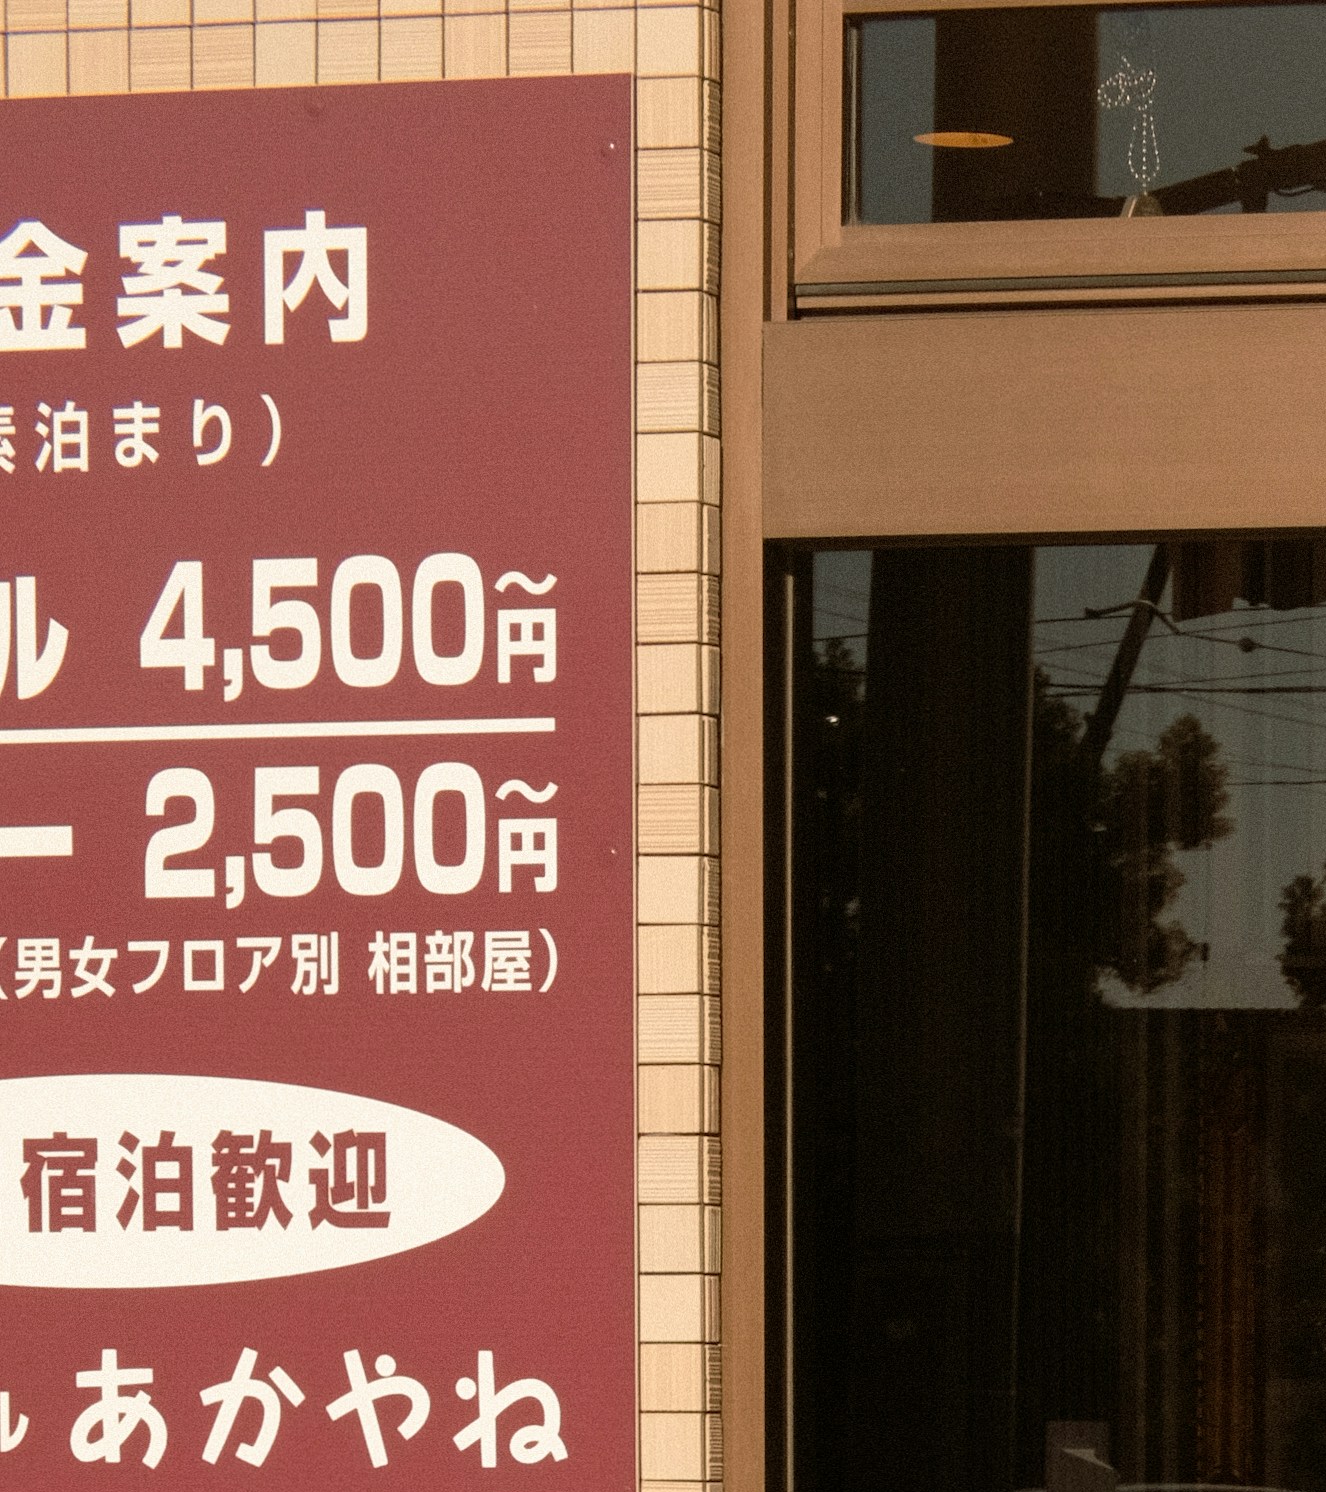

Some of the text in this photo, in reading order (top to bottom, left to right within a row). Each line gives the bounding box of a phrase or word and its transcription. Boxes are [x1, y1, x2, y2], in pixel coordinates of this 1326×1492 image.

[21, 1130, 392, 1234] 宿泊歓迎
[70, 1348, 570, 1471] あかやね
